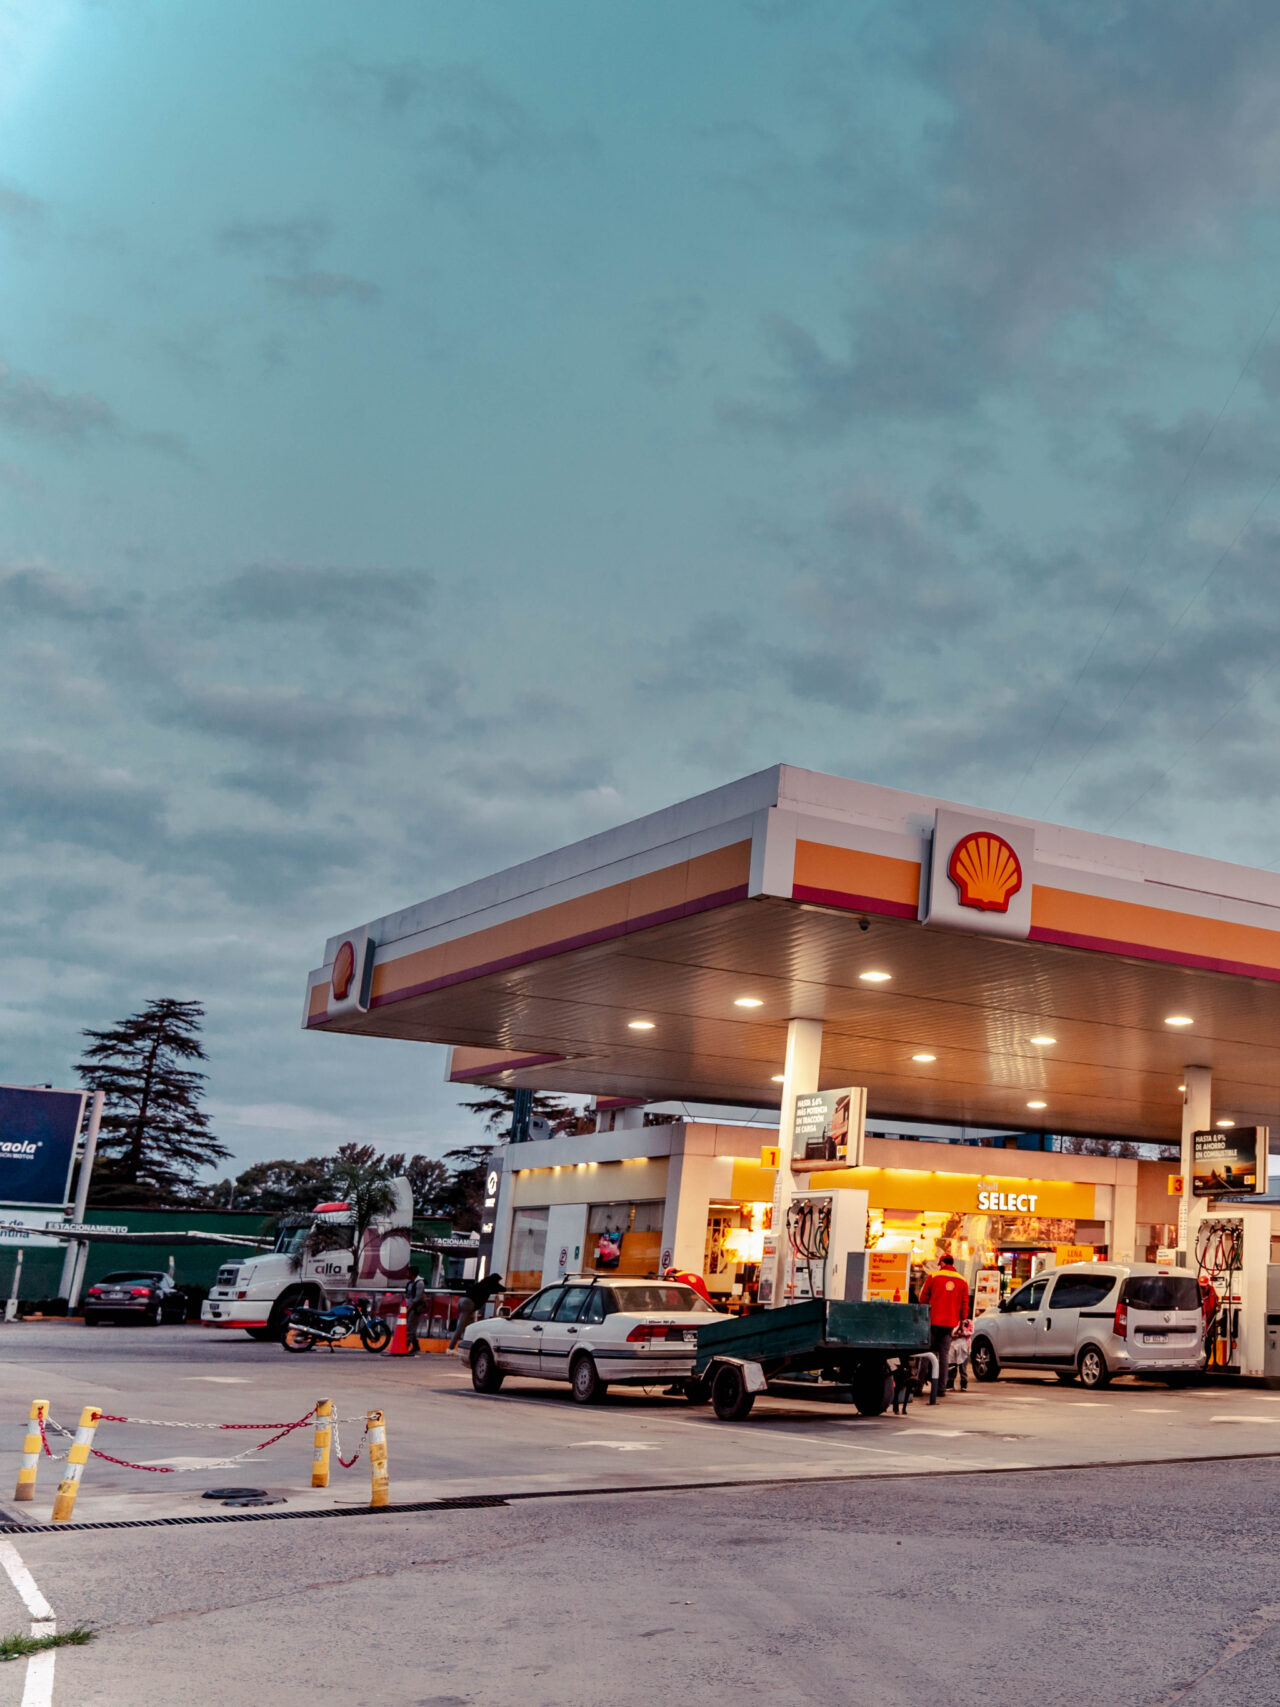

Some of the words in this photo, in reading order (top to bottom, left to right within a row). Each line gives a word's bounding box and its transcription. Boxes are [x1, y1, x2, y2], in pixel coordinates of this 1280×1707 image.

[770, 1151, 776, 1166] 1
[1174, 1179, 1182, 1192] 3
[978, 1192, 1038, 1212] SELECT
[315, 1263, 342, 1274] alfa
